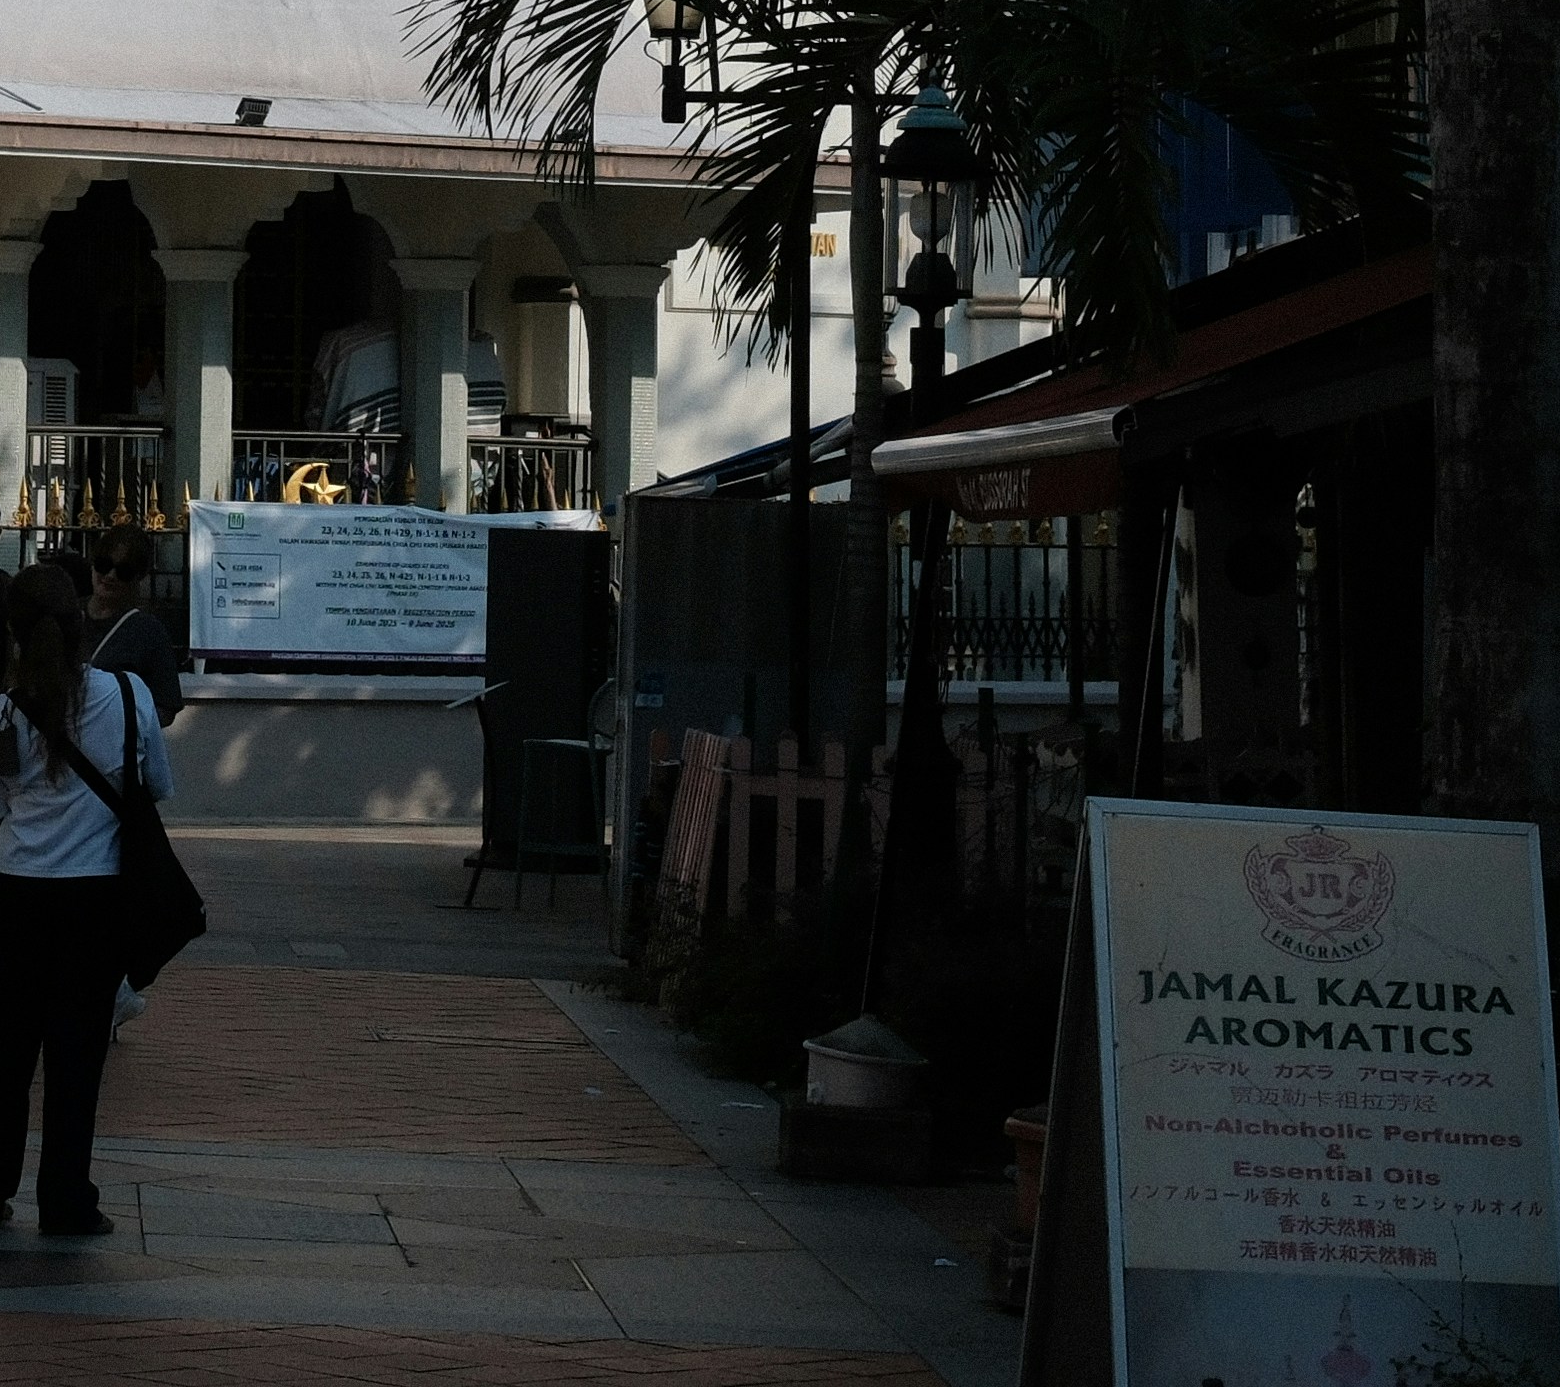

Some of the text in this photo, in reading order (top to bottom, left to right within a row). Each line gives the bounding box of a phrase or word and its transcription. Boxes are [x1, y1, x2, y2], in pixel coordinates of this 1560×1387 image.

[322, 527, 334, 536] 23,
[337, 527, 350, 536] 24,
[353, 527, 366, 536] 25,
[416, 530, 439, 538] N-1-1
[442, 530, 449, 538] &
[452, 531, 476, 539] N-1-2
[357, 619, 376, 627] June
[1300, 874, 1343, 900] JR
[1271, 928, 1374, 959] FRAGRANCE
[1139, 970, 1515, 1015] JAMAL KAZURA
[1184, 1015, 1474, 1056] AROMATICS
[1168, 1058, 1494, 1088] ジャマル カズラ アロマティクス
[1145, 1114, 1523, 1149] Non-Alchoholic Perfumes
[1325, 1144, 1346, 1160] &
[1232, 1160, 1441, 1188] Essential Oils
[1128, 1183, 1544, 1217] ノンアルコール香水 & エッセンシャルオイル
[1278, 1214, 1396, 1239] 香水天然精油
[1239, 1238, 1438, 1267] 无酒精香水和天然精油
